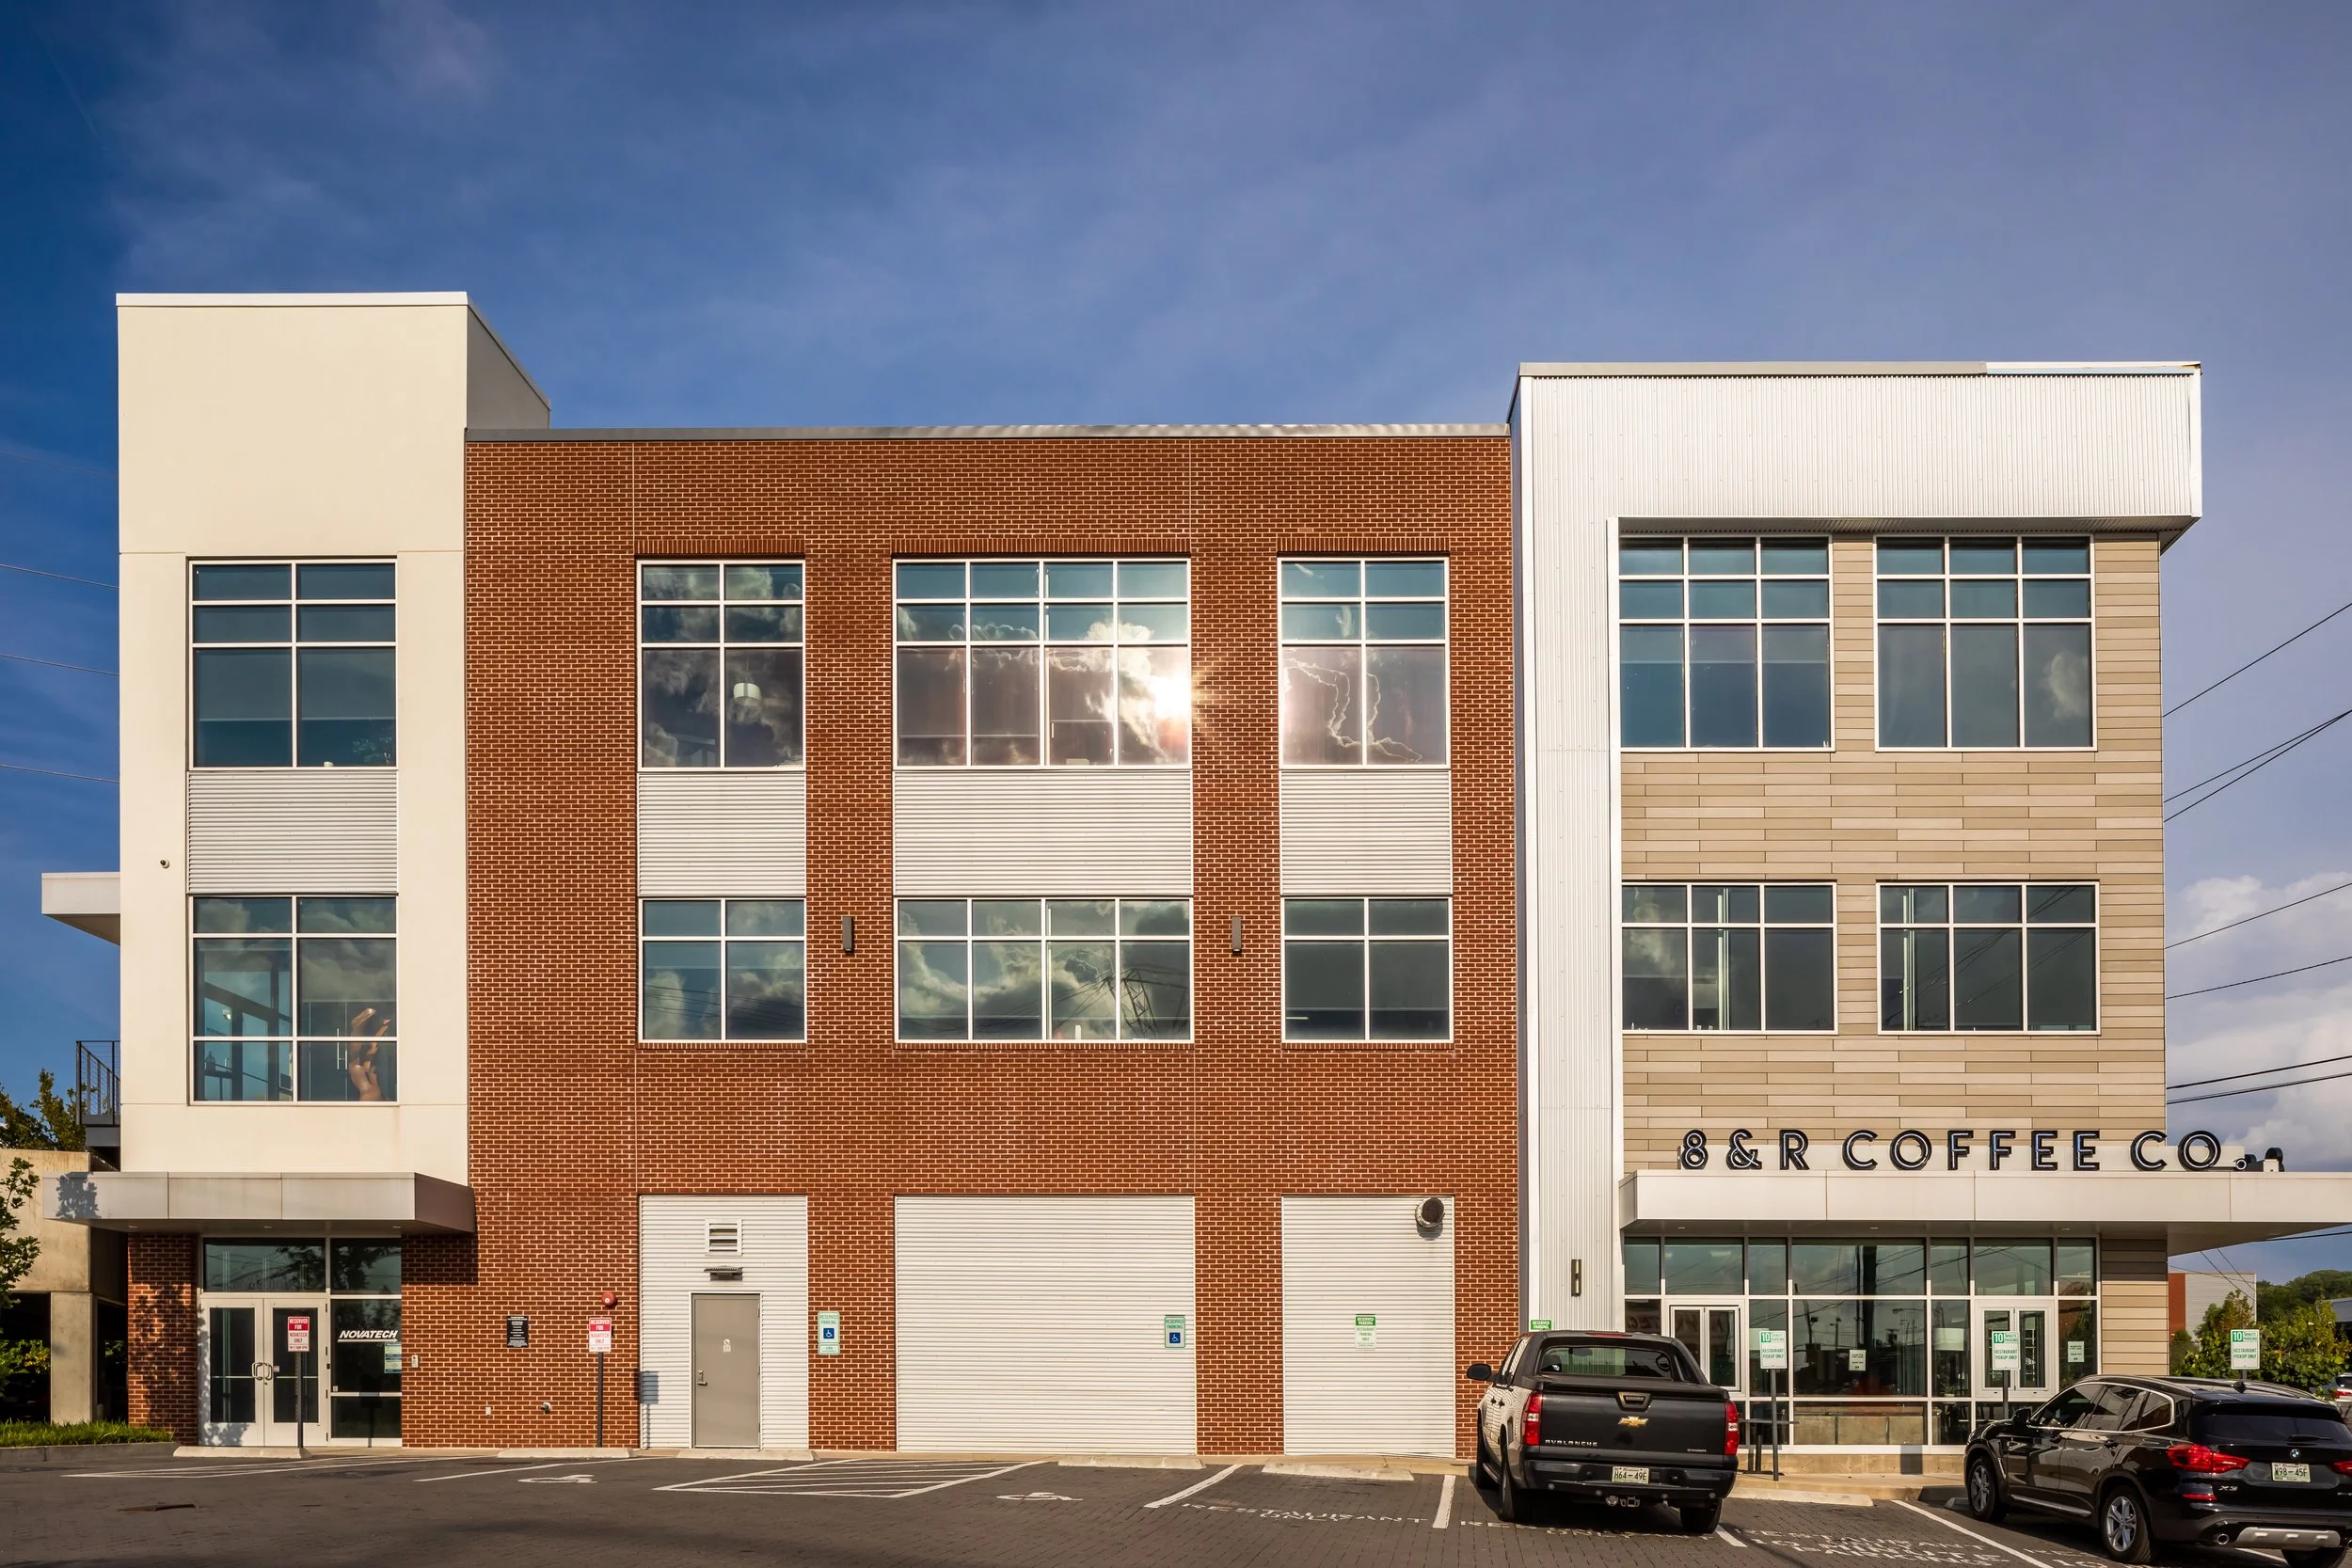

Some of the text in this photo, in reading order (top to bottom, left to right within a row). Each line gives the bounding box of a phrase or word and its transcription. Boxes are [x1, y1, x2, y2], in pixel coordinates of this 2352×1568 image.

[1841, 1129, 2100, 1171] COFFEE
[340, 1330, 398, 1338] NOVATECH
[1761, 1332, 1771, 1342] 10
[1994, 1333, 2004, 1343] 10
[2233, 1331, 2243, 1341] 10
[1182, 1503, 1429, 1523] RESTAURANT
[1793, 1546, 1995, 1567] PARKING
[1820, 1543, 2010, 1561] MINUTE
